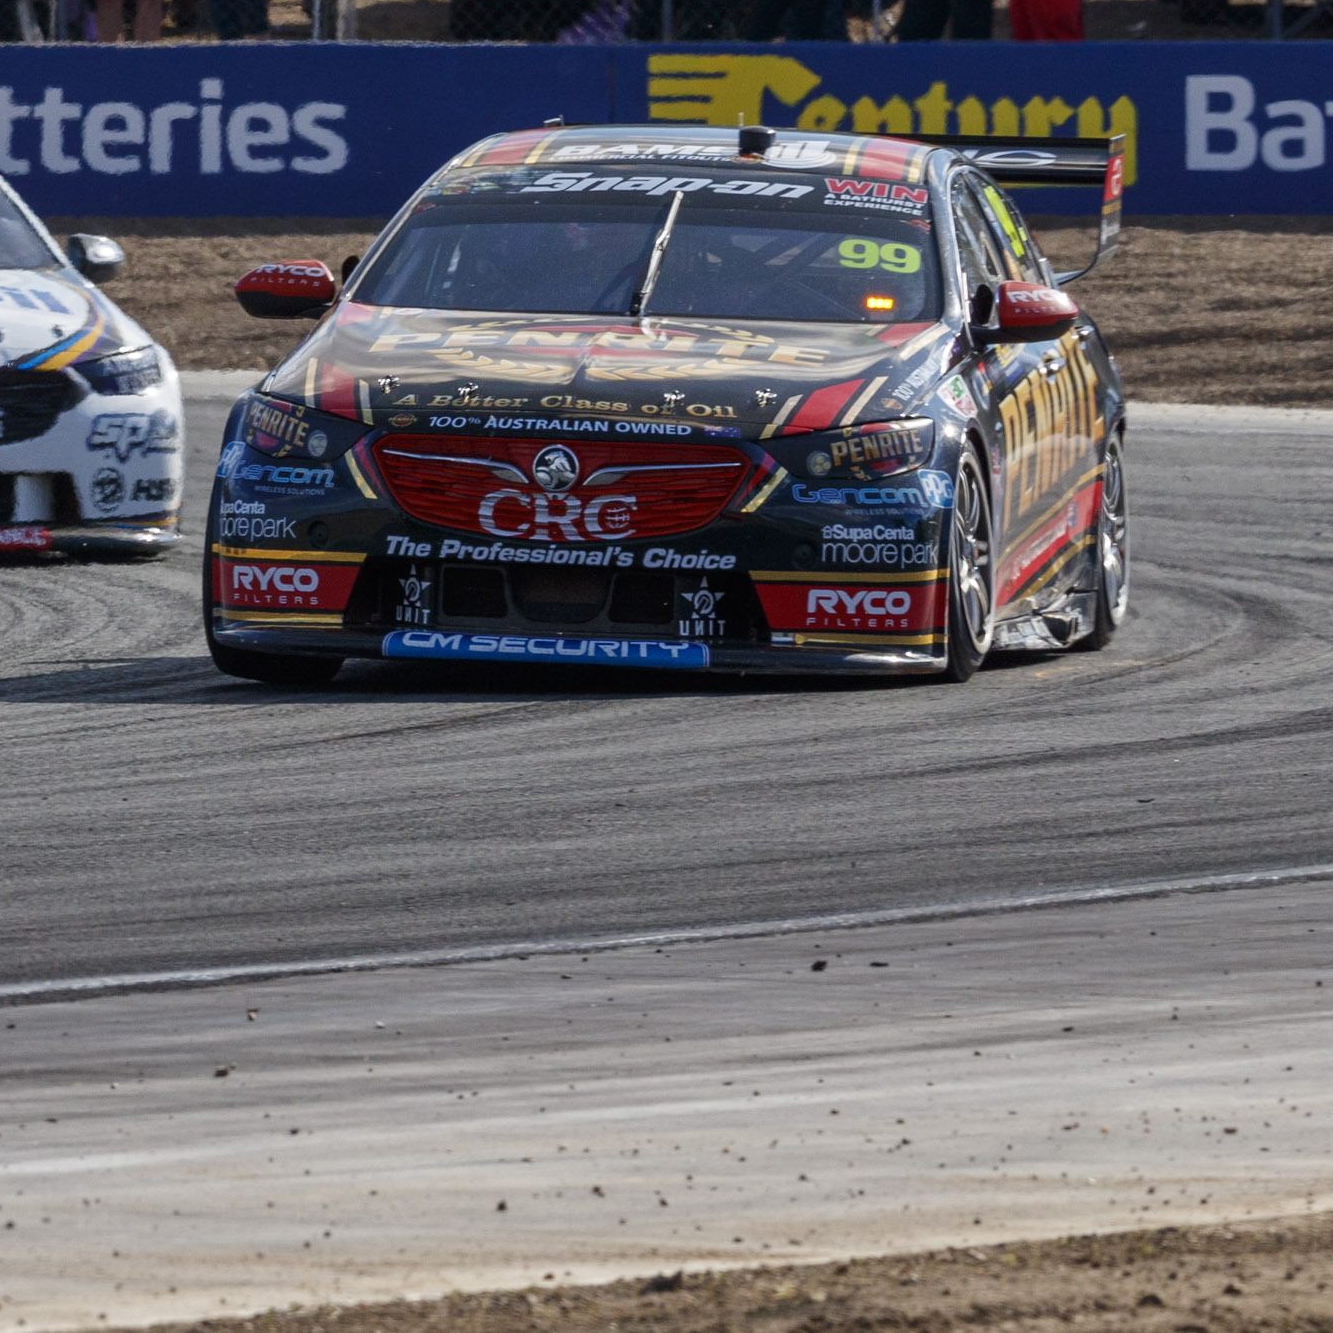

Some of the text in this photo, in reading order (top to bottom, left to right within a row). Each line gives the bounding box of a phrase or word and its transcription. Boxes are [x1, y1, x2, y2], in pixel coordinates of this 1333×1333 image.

[520, 172, 815, 198] Snap-on
[824, 178, 929, 204] WIN
[823, 199, 923, 216] EXPERIENCE
[837, 193, 924, 210] BATHURST
[837, 238, 922, 274] 99
[253, 263, 326, 278] RYCO
[368, 330, 831, 366] PENRITE
[392, 393, 420, 406] A
[427, 393, 529, 409] Better
[540, 395, 629, 413] Class
[686, 403, 738, 418] Oil
[246, 399, 310, 448] PENRITE
[429, 416, 693, 436] 100% AUSTRALIAN OWNED
[998, 328, 1107, 534] PENRITE
[830, 429, 925, 467] PENRITE
[791, 483, 925, 507] Gencom
[478, 488, 638, 543] CRC
[250, 516, 297, 542] park
[832, 524, 916, 544] SupaCenta
[386, 534, 737, 571] The Professional's Choice
[821, 541, 939, 569] moore park
[233, 565, 320, 592] RYCO
[233, 593, 320, 606] FILTERS
[806, 588, 912, 616] RYCO
[395, 605, 432, 625] UNIT
[678, 619, 727, 637] UNIT
[806, 617, 910, 629] FILTERS
[401, 632, 690, 658] CM SECURITY
